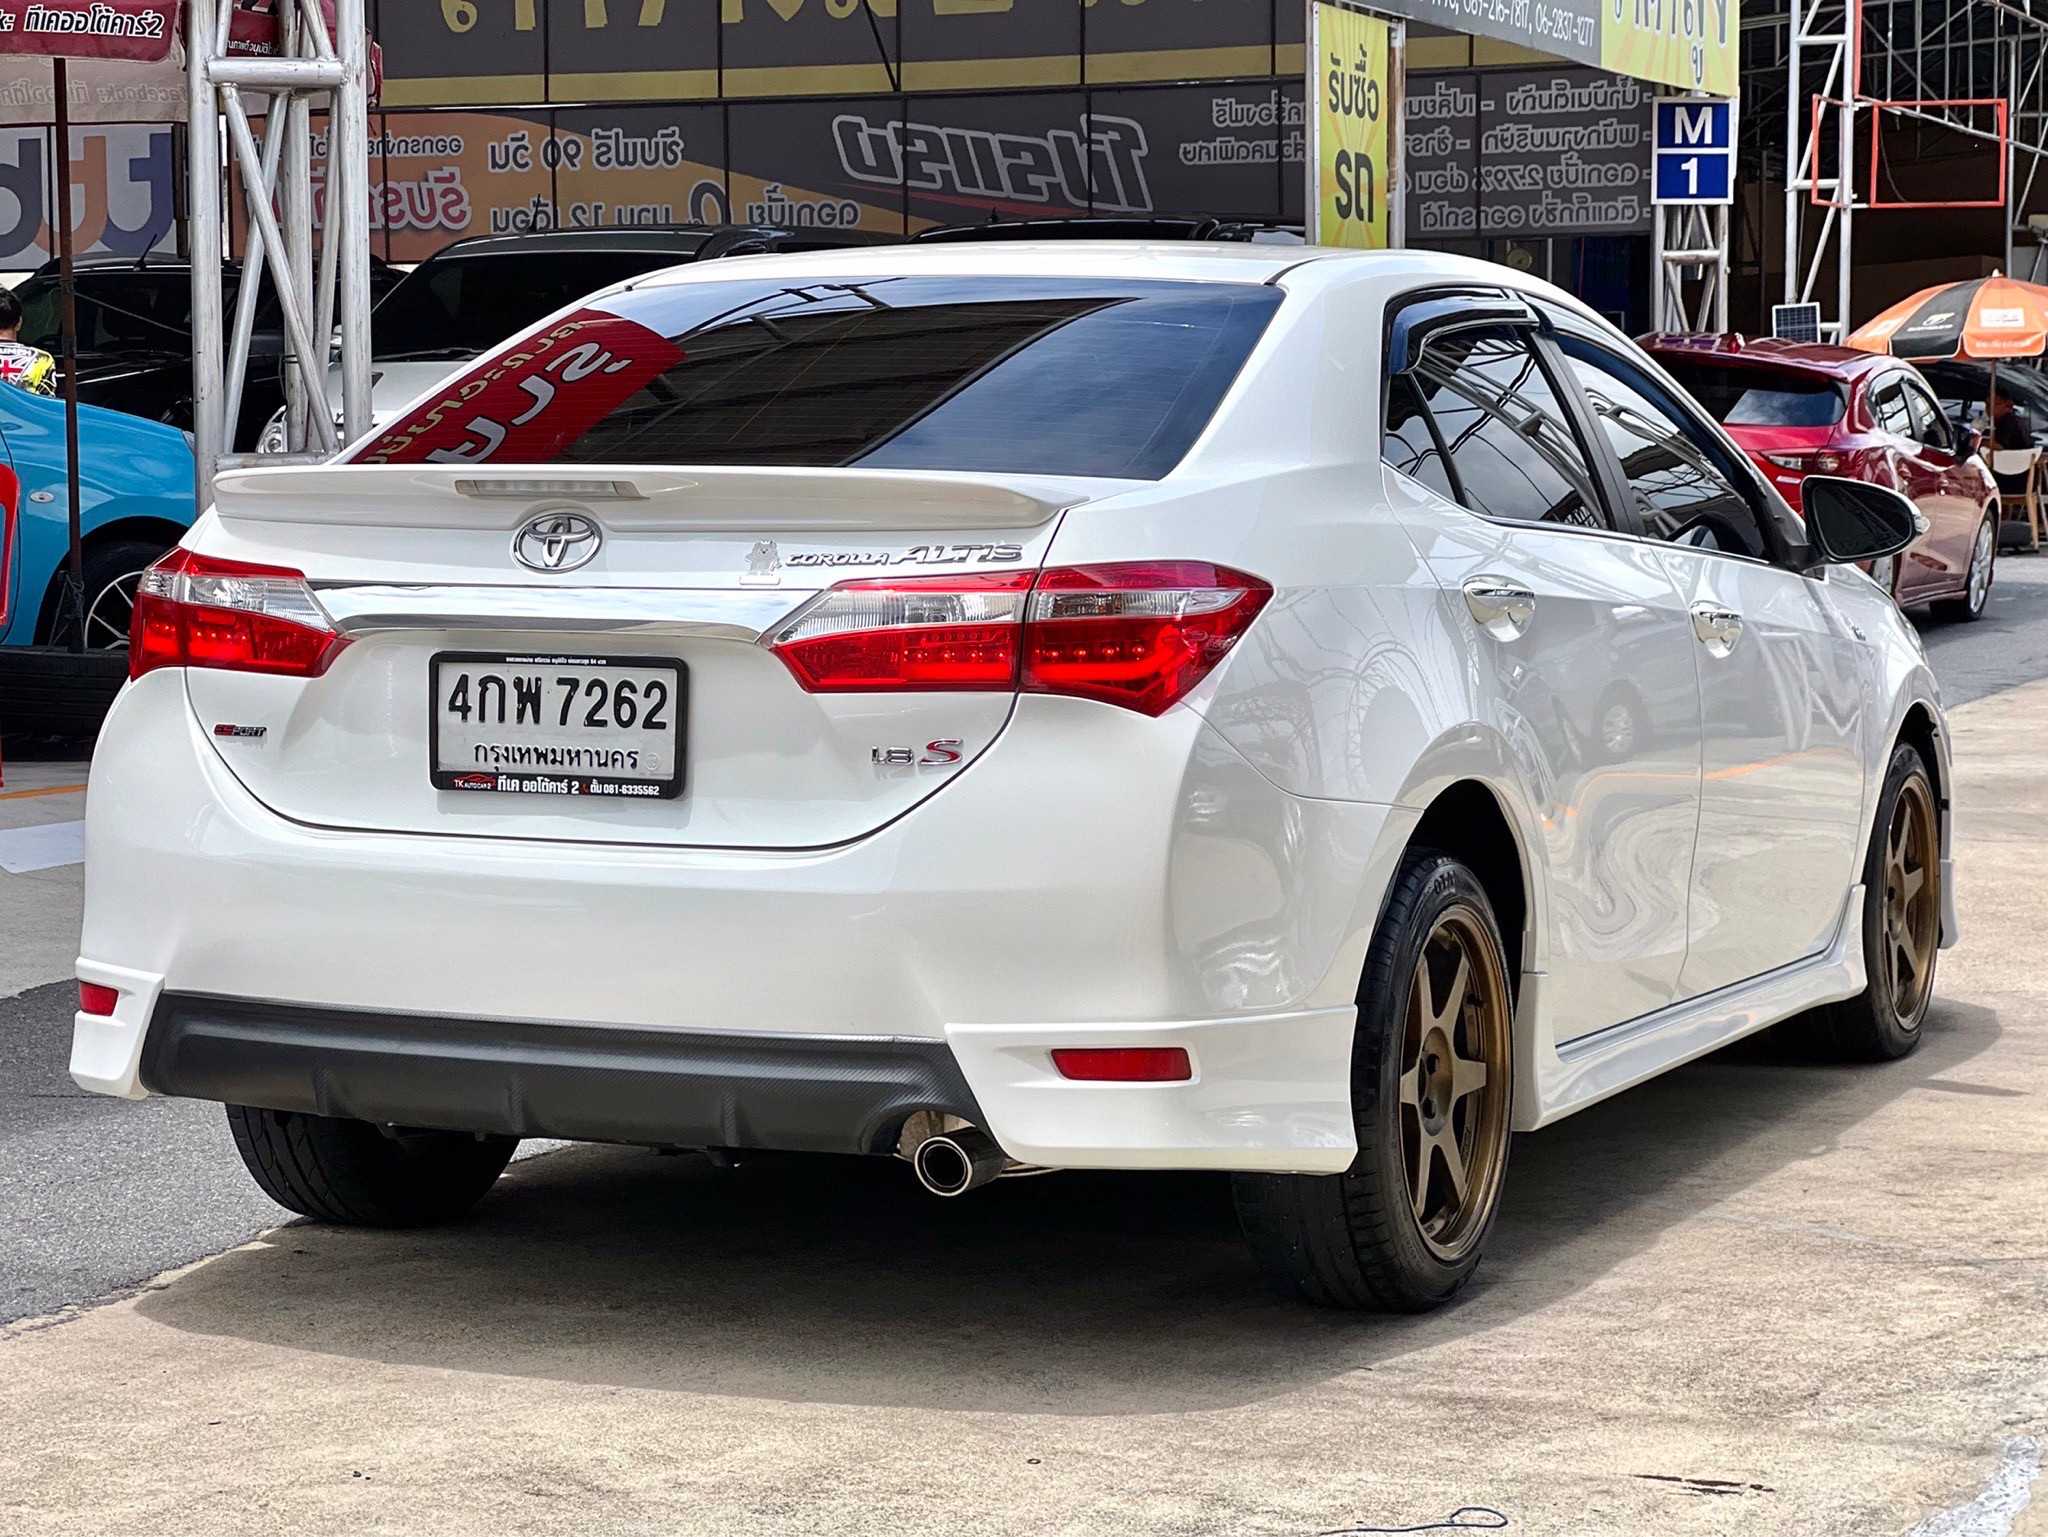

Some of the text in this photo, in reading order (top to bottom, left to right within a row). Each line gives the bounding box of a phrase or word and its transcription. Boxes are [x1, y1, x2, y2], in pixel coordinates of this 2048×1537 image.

[1328, 43, 1379, 122] รับซื้อ
[1674, 106, 1713, 144] M
[1335, 149, 1374, 223] รถ
[1680, 156, 1698, 195] 1
[785, 543, 1023, 567] COROLLA ALTIS
[556, 676, 668, 730] 7262
[473, 743, 640, 772] กรุงเทพมหานคร
[497, 774, 520, 792] ทีเค
[571, 781, 580, 795] 2
